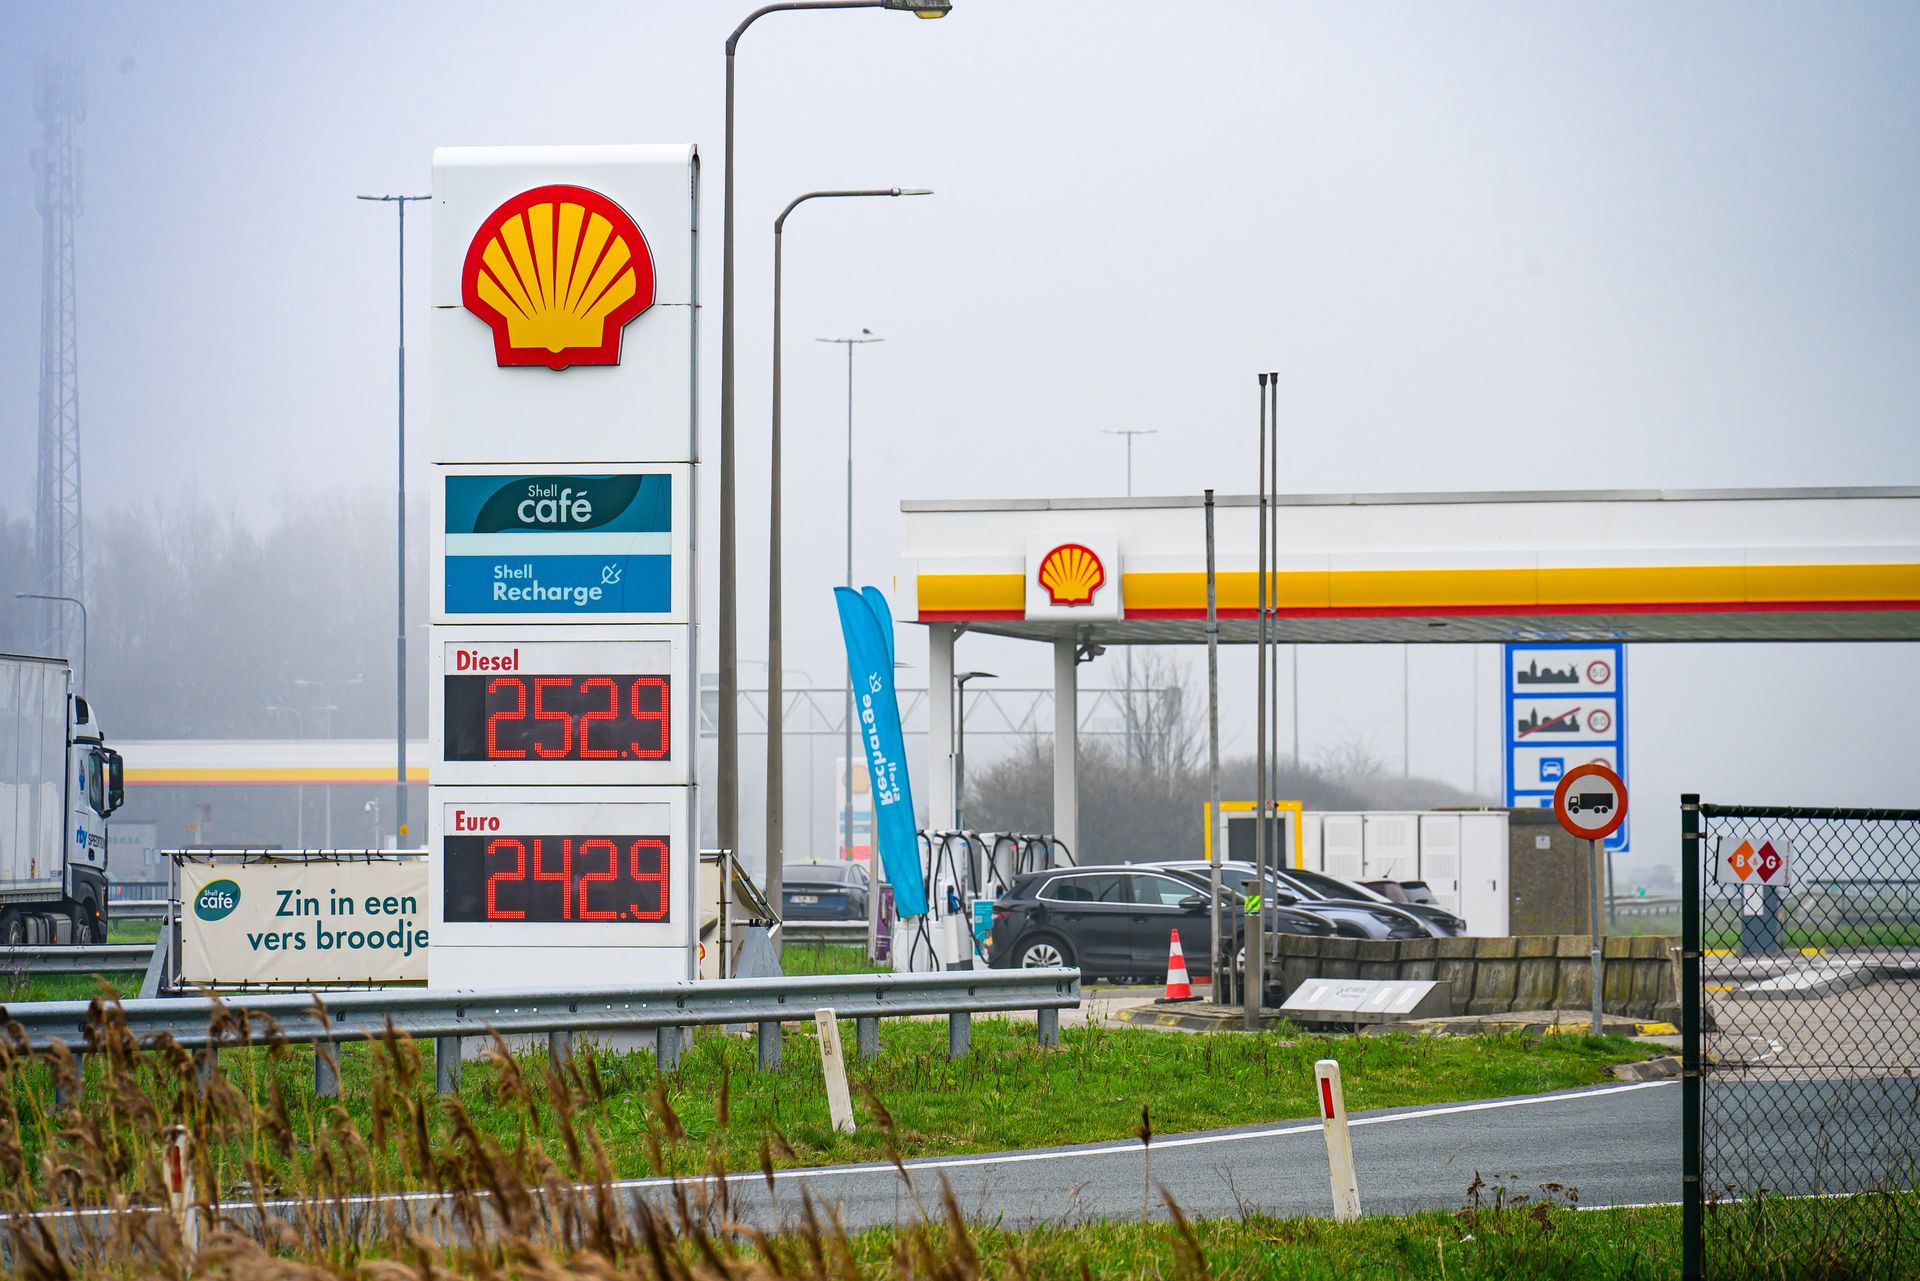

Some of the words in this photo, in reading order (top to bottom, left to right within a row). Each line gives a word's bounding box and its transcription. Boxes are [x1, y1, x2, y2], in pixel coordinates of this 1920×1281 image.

[528, 484, 557, 498] Shell
[517, 488, 592, 523] café
[494, 564, 532, 579] Shell
[493, 580, 602, 606] Recharge
[456, 648, 519, 671] Diesel
[488, 677, 669, 758] 252.9
[455, 810, 500, 831] Euro
[1736, 854, 1745, 867] B
[1766, 856, 1777, 869] G
[487, 839, 669, 920] 242.9
[200, 891, 233, 909] café
[276, 889, 319, 917] Zin
[330, 888, 354, 915] in
[364, 895, 417, 915] een
[247, 931, 306, 950] vers
[316, 918, 429, 957] broodje
